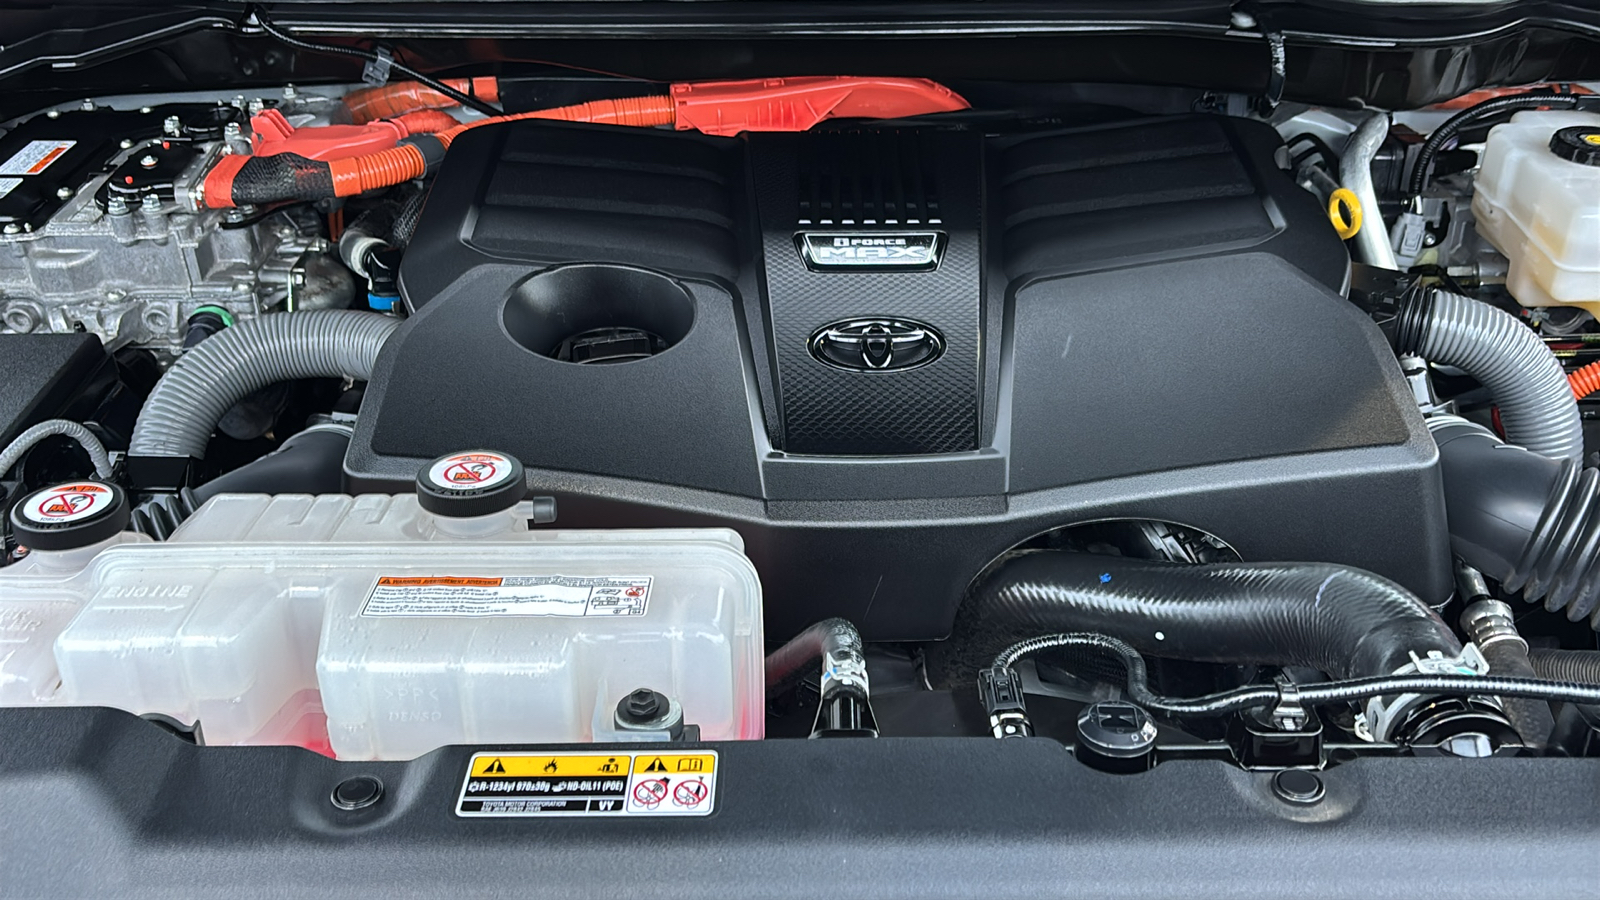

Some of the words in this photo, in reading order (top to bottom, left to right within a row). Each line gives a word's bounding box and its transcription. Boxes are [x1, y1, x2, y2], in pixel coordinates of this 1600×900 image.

[820, 246, 926, 258] MAX
[102, 585, 193, 599] ENGINE
[388, 711, 442, 722] DENSO
[602, 780, 624, 792] (POE)
[599, 801, 615, 811] VY
